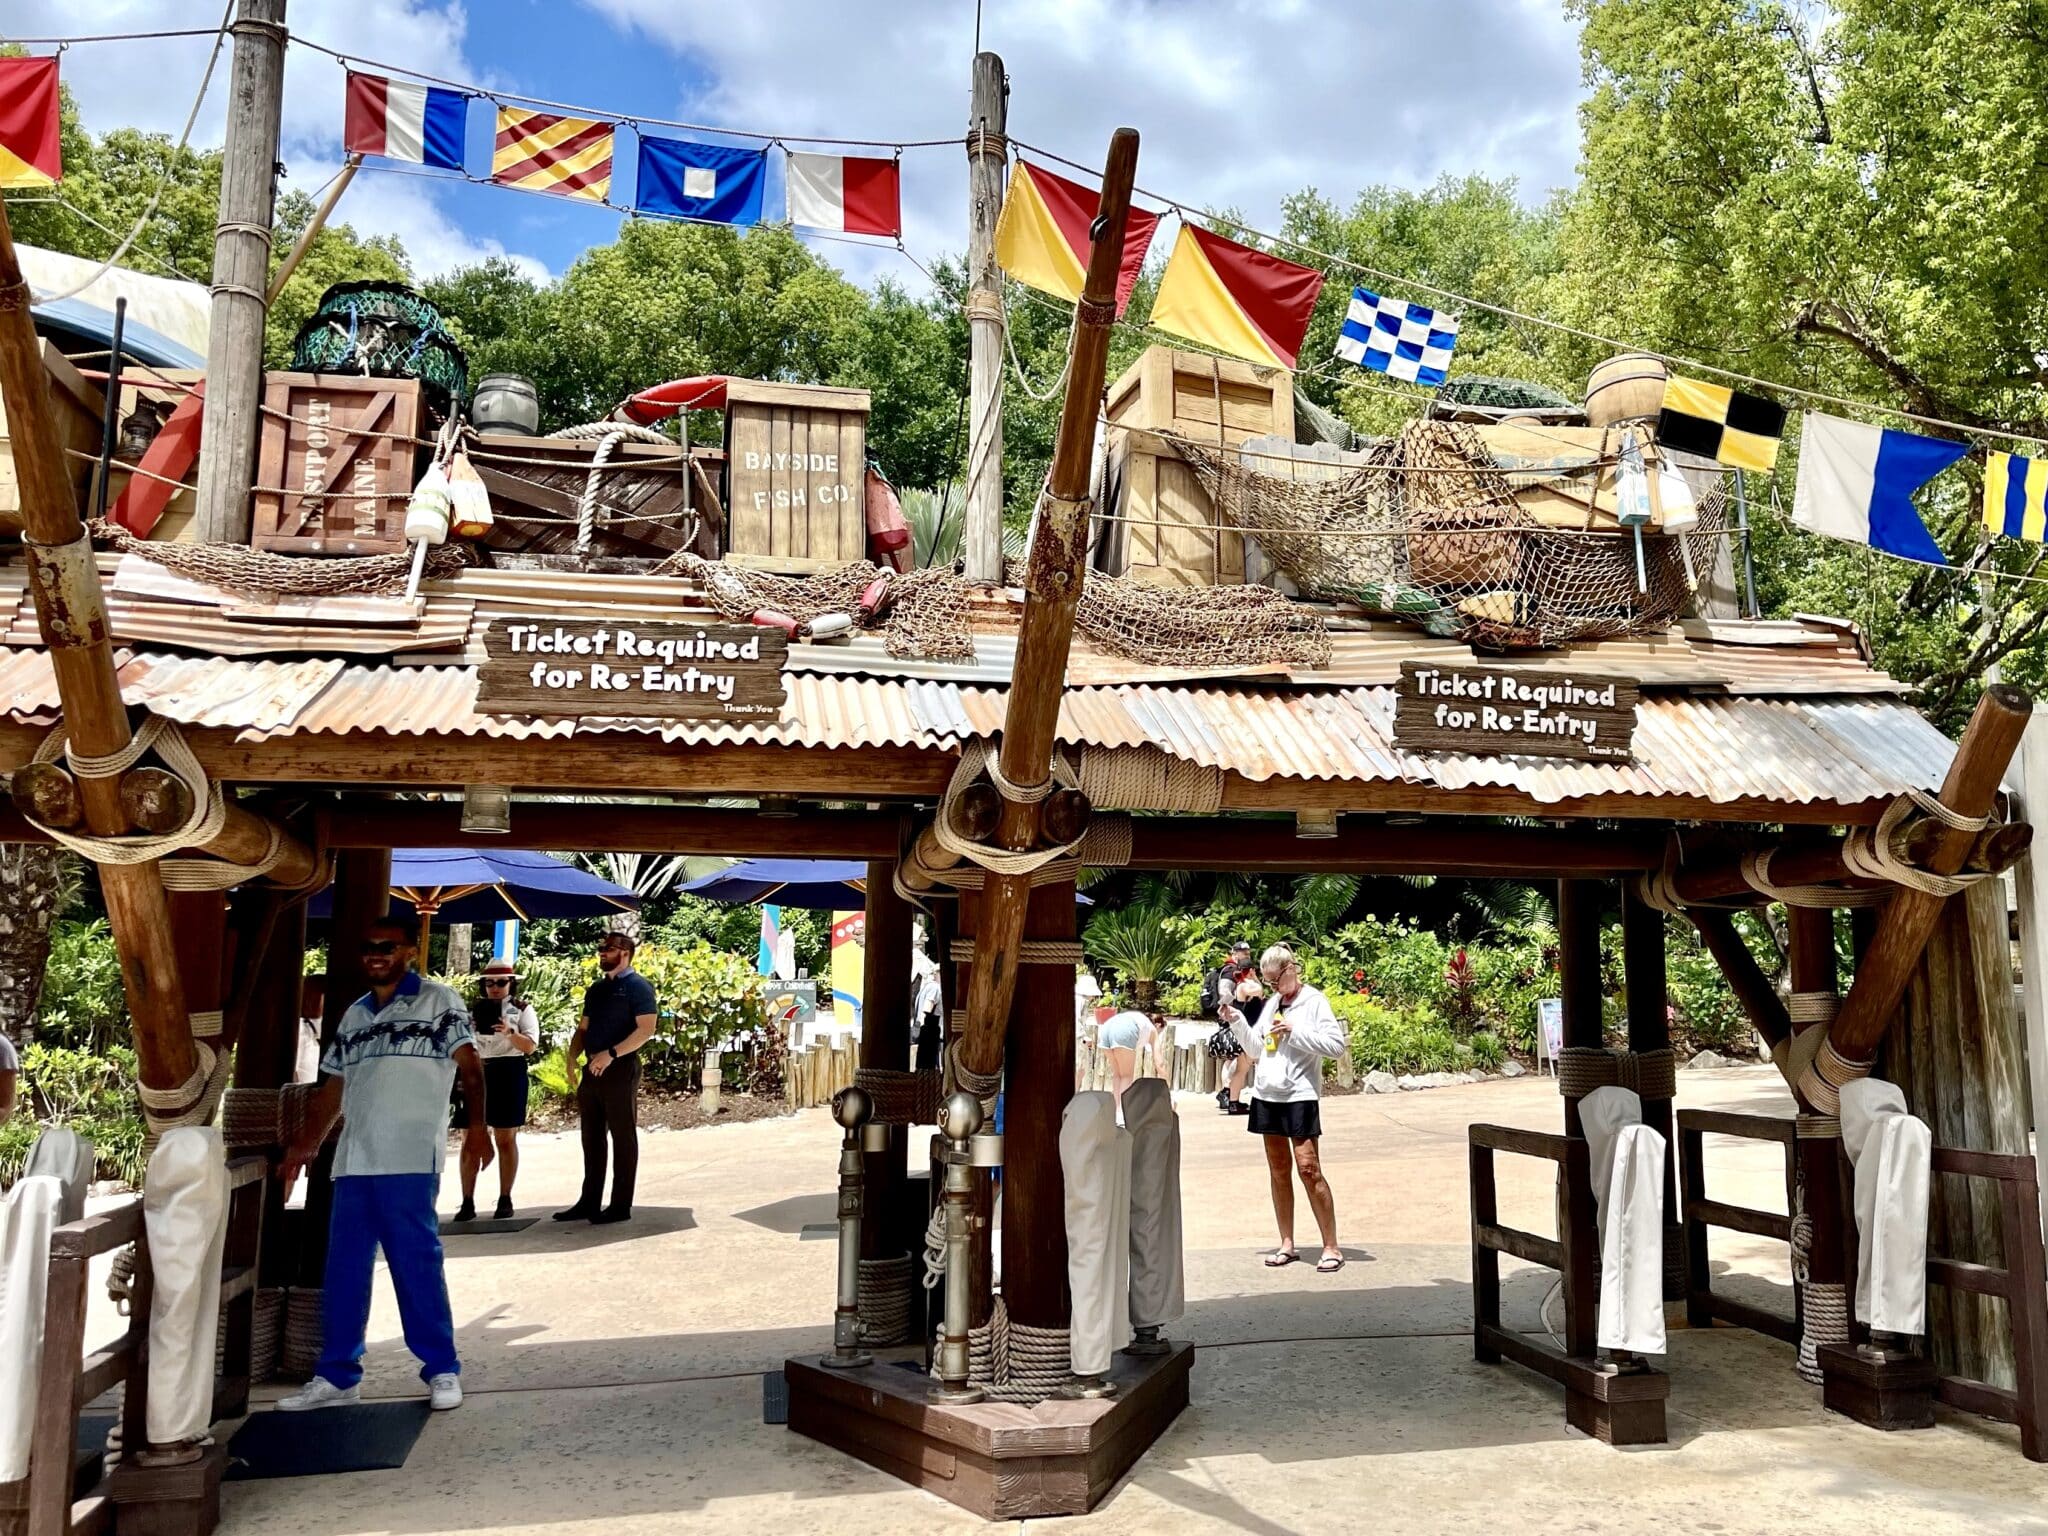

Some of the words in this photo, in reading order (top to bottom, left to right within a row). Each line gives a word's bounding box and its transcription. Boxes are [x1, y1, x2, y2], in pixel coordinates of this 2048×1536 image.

[300, 398, 331, 530] EASTPORT
[745, 452, 838, 472] BAYSIDE
[353, 458, 376, 537] MAINE
[753, 488, 806, 511] FISH
[507, 625, 611, 655] Ticket
[616, 630, 760, 666] Required
[530, 662, 583, 690] for
[590, 663, 736, 700] Re-Entry
[1415, 669, 1496, 696] Ticket
[1502, 677, 1615, 709] Required
[723, 703, 754, 714] Thank
[755, 704, 774, 714] You
[1434, 703, 1477, 730] for
[1482, 706, 1597, 743] Re-Entry
[1587, 745, 1612, 756] Thank
[1613, 747, 1629, 757] You
